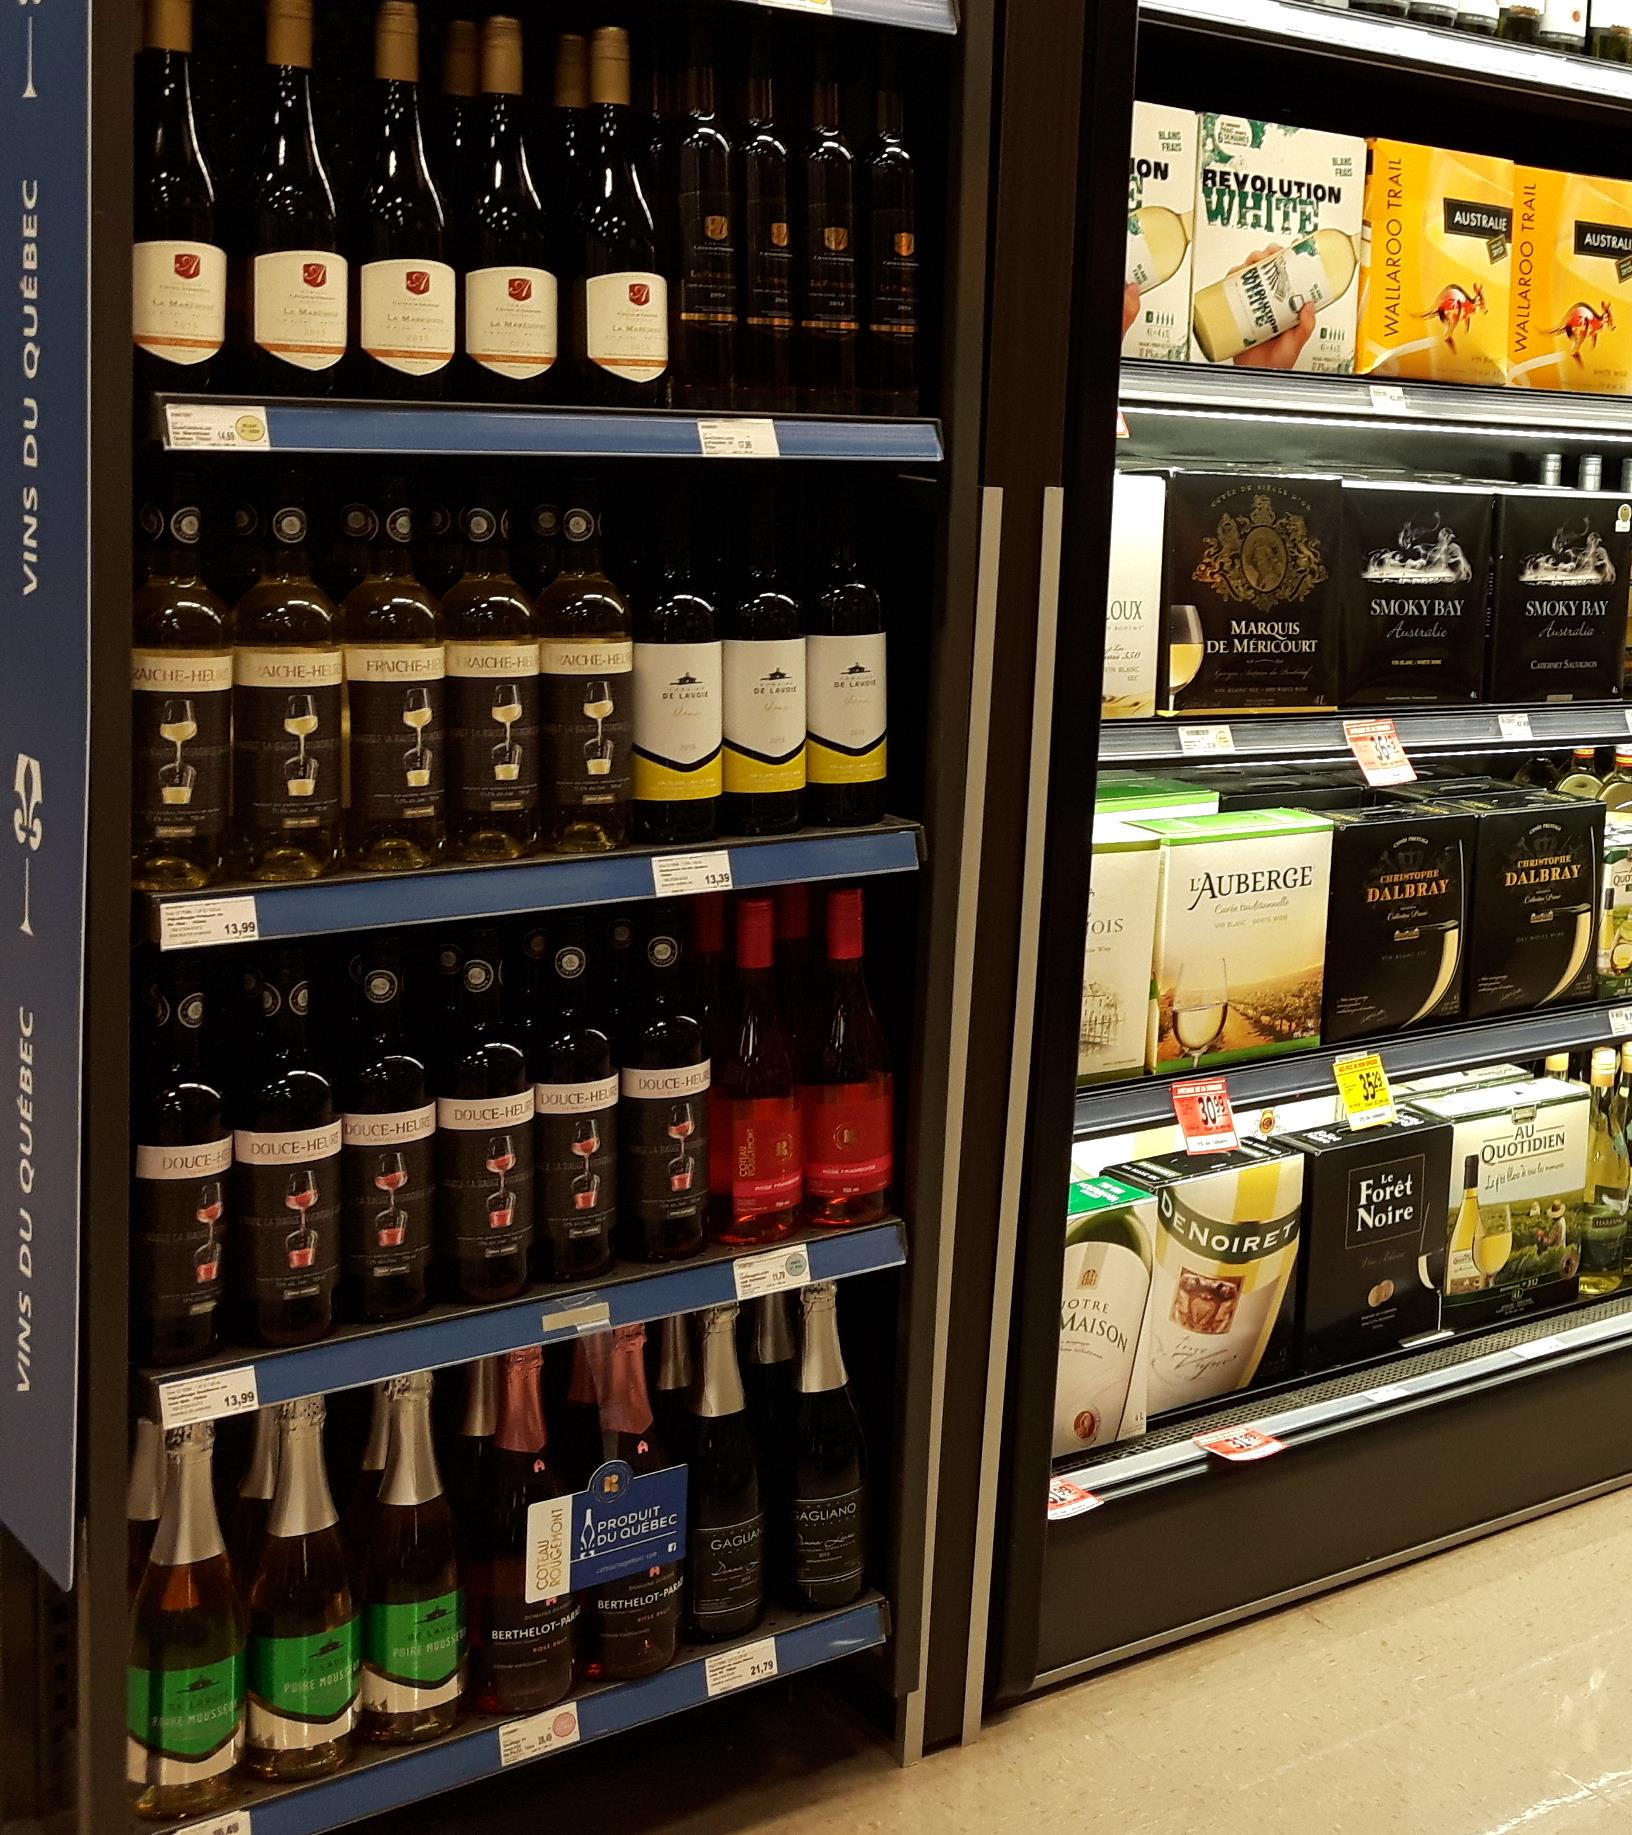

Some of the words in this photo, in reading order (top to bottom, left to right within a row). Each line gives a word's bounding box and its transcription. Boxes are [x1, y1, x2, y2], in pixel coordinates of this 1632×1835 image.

[1202, 168, 1341, 204] REVOLUTION
[1387, 157, 1403, 209] TRAIL
[1203, 186, 1319, 235] WHITE
[1453, 210, 1508, 232] AUSTRALIE
[1522, 182, 1537, 233] TRAIL
[19, 179, 41, 380] QUÉBEC
[1383, 219, 1403, 337] WALLAROO
[1513, 240, 1536, 352] WALLAROO
[22, 396, 38, 468] DU
[22, 487, 38, 596] VINS
[1370, 598, 1430, 616] SMOKY
[1433, 599, 1465, 616] BAY
[1525, 600, 1578, 617] SMOKY
[1581, 600, 1608, 616] BAY
[1230, 620, 1300, 640] MARQUIS
[1386, 620, 1448, 639] Australie
[1537, 620, 1595, 640] Australia
[1206, 640, 1228, 653] DE
[1233, 637, 1318, 653] MÉRICOURT
[1505, 864, 1581, 887] DALBRAY
[1517, 854, 1572, 868] CHRISTOPHE
[704, 872, 730, 886] 13,39
[1187, 865, 1313, 911] L'AUBERGE
[1366, 879, 1450, 903] DALBRAY
[1380, 869, 1440, 884] CHRISTOPHE
[224, 921, 256, 936] 13,99
[16, 1006, 35, 1194] QUÉBEC
[1514, 1124, 1535, 1141] AU
[1481, 1132, 1566, 1166] QUOTIDIEN
[1358, 1174, 1413, 1207] Forêt
[1381, 1173, 1394, 1185] Le
[1356, 1203, 1414, 1233] Noire
[18, 1208, 33, 1278] DU
[16, 1289, 32, 1393] VINS
[224, 1391, 255, 1407] 13,99
[597, 1505, 661, 1533] PRODUIT
[597, 1531, 617, 1546] DU
[619, 1513, 677, 1539] QUÉBEC
[549, 1508, 563, 1587] ROUGEMONT
[536, 1539, 550, 1591] COTEAU
[750, 1660, 774, 1676] 21,79
